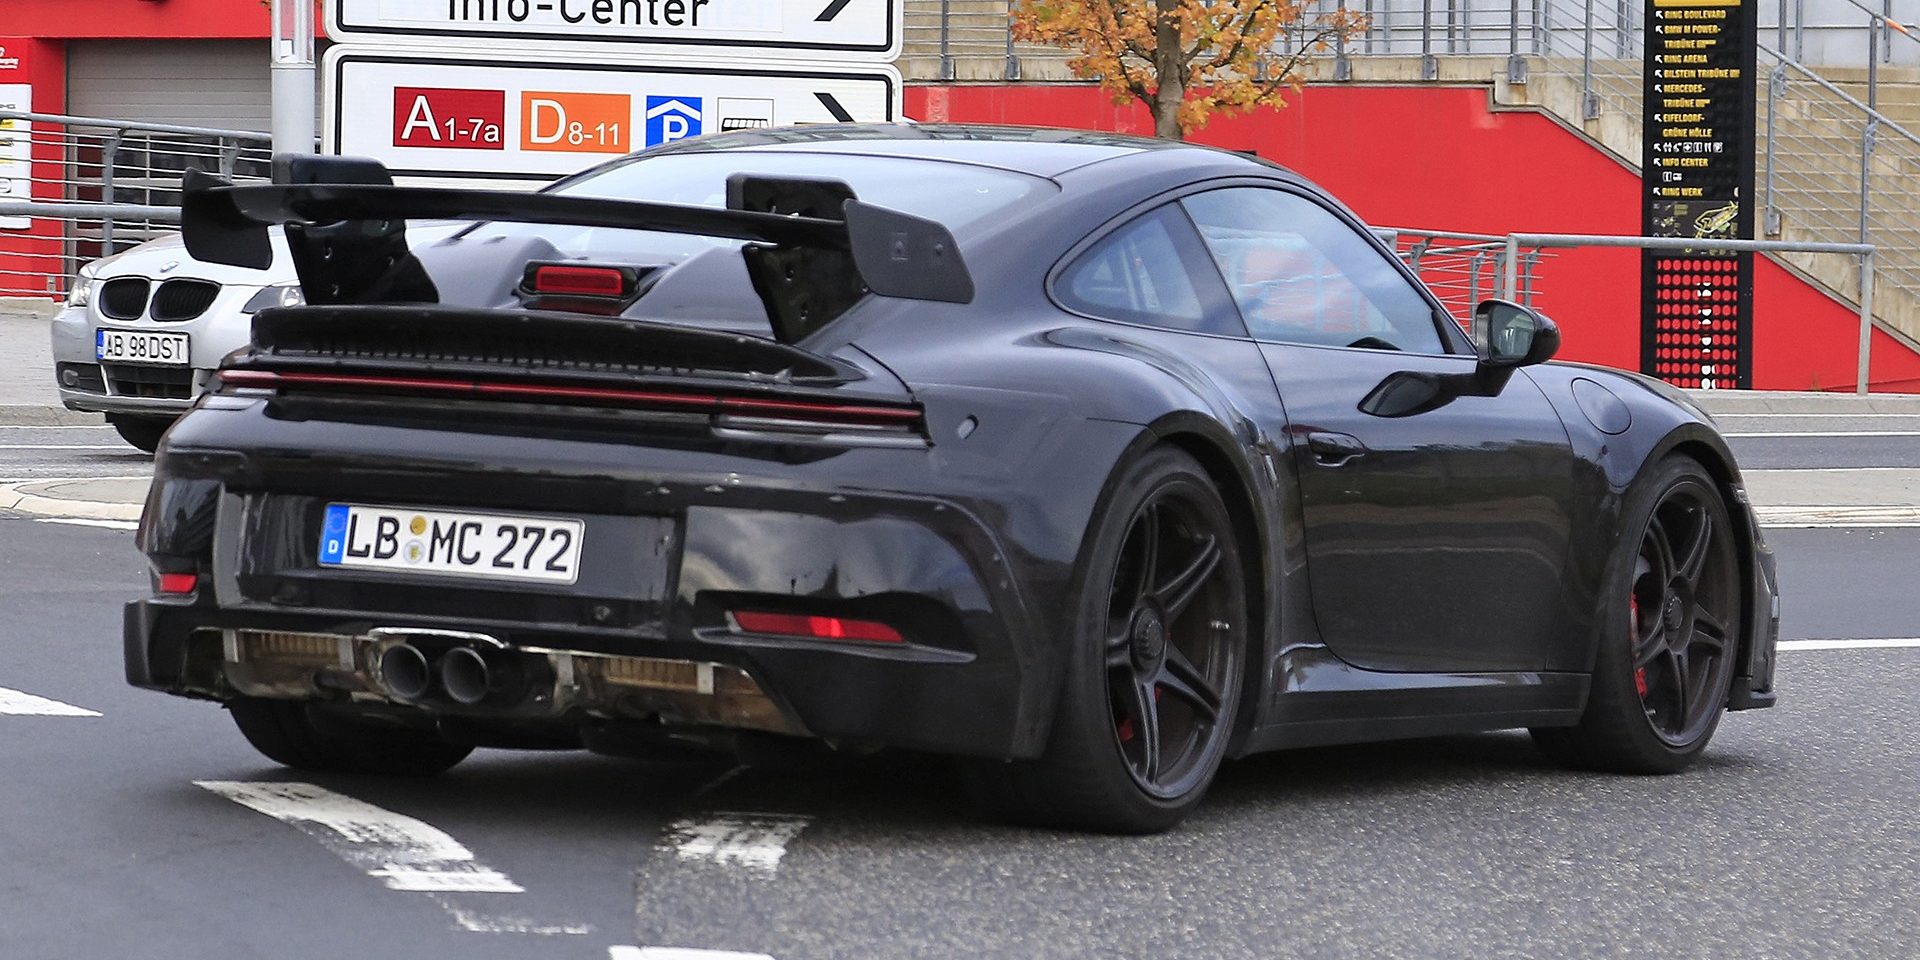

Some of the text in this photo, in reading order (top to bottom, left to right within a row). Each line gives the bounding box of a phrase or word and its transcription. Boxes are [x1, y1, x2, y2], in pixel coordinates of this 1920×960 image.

[449, 0, 709, 26] Info-Center
[1683, 9, 1726, 19] BOULEVARD
[1664, 25, 1721, 34] BMW M POWER-
[1664, 38, 1696, 48] TRIBÜNE
[1663, 54, 1708, 63] RING ARENA
[1663, 69, 1696, 78] BILSTEIN
[1697, 67, 1729, 78] TRIBÜNE
[1663, 84, 1706, 93] MERCEDES-
[1663, 97, 1695, 107] TRIBÜNE
[1663, 113, 1705, 122] EIFELDORF-
[662, 115, 689, 144] P
[1663, 127, 1712, 137] GRÜNE HÖLLE
[1662, 157, 1709, 167] INFO CENTER
[1662, 187, 1703, 196] RING WERK
[106, 335, 124, 357] AB
[346, 513, 572, 573] LB MC 272
